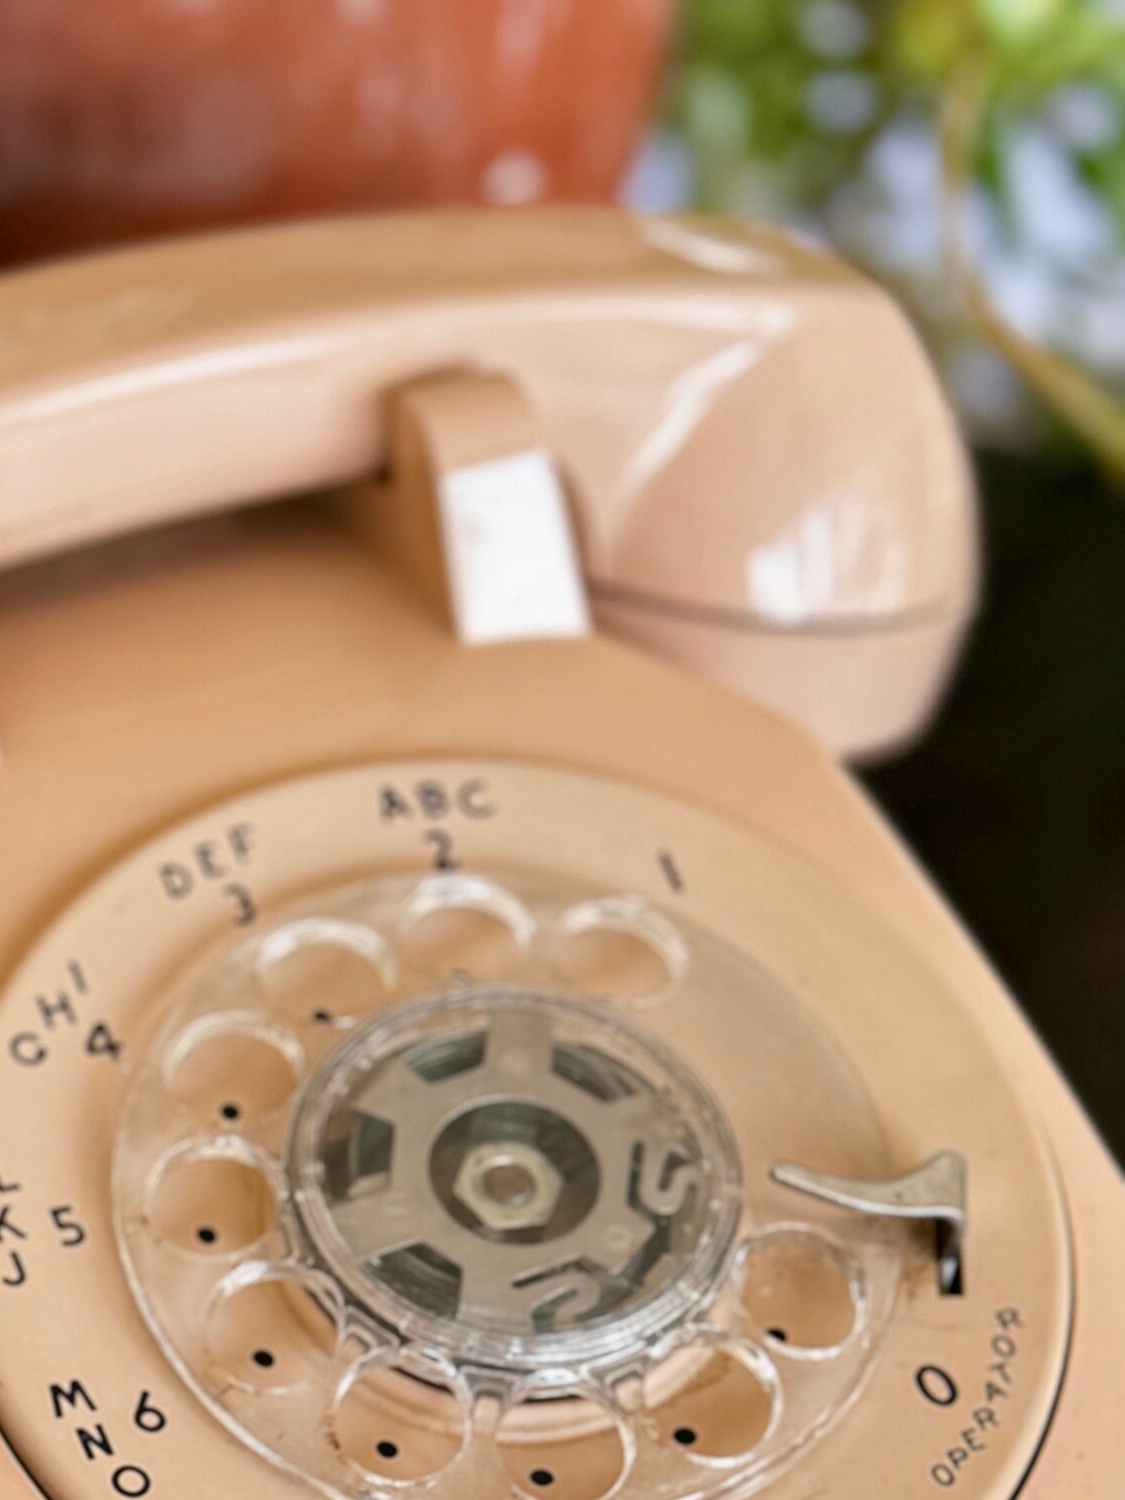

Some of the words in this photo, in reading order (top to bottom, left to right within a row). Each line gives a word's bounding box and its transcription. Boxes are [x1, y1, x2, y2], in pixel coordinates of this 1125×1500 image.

[378, 780, 494, 821] ABC
[157, 823, 256, 899] DEF
[423, 830, 461, 871] 2
[657, 849, 686, 893] 1
[222, 885, 260, 927] 3
[83, 1020, 124, 1061] 4
[49, 1205, 87, 1247] 5
[133, 1389, 167, 1434] 6
[931, 1306, 1023, 1488] OPERATOR
